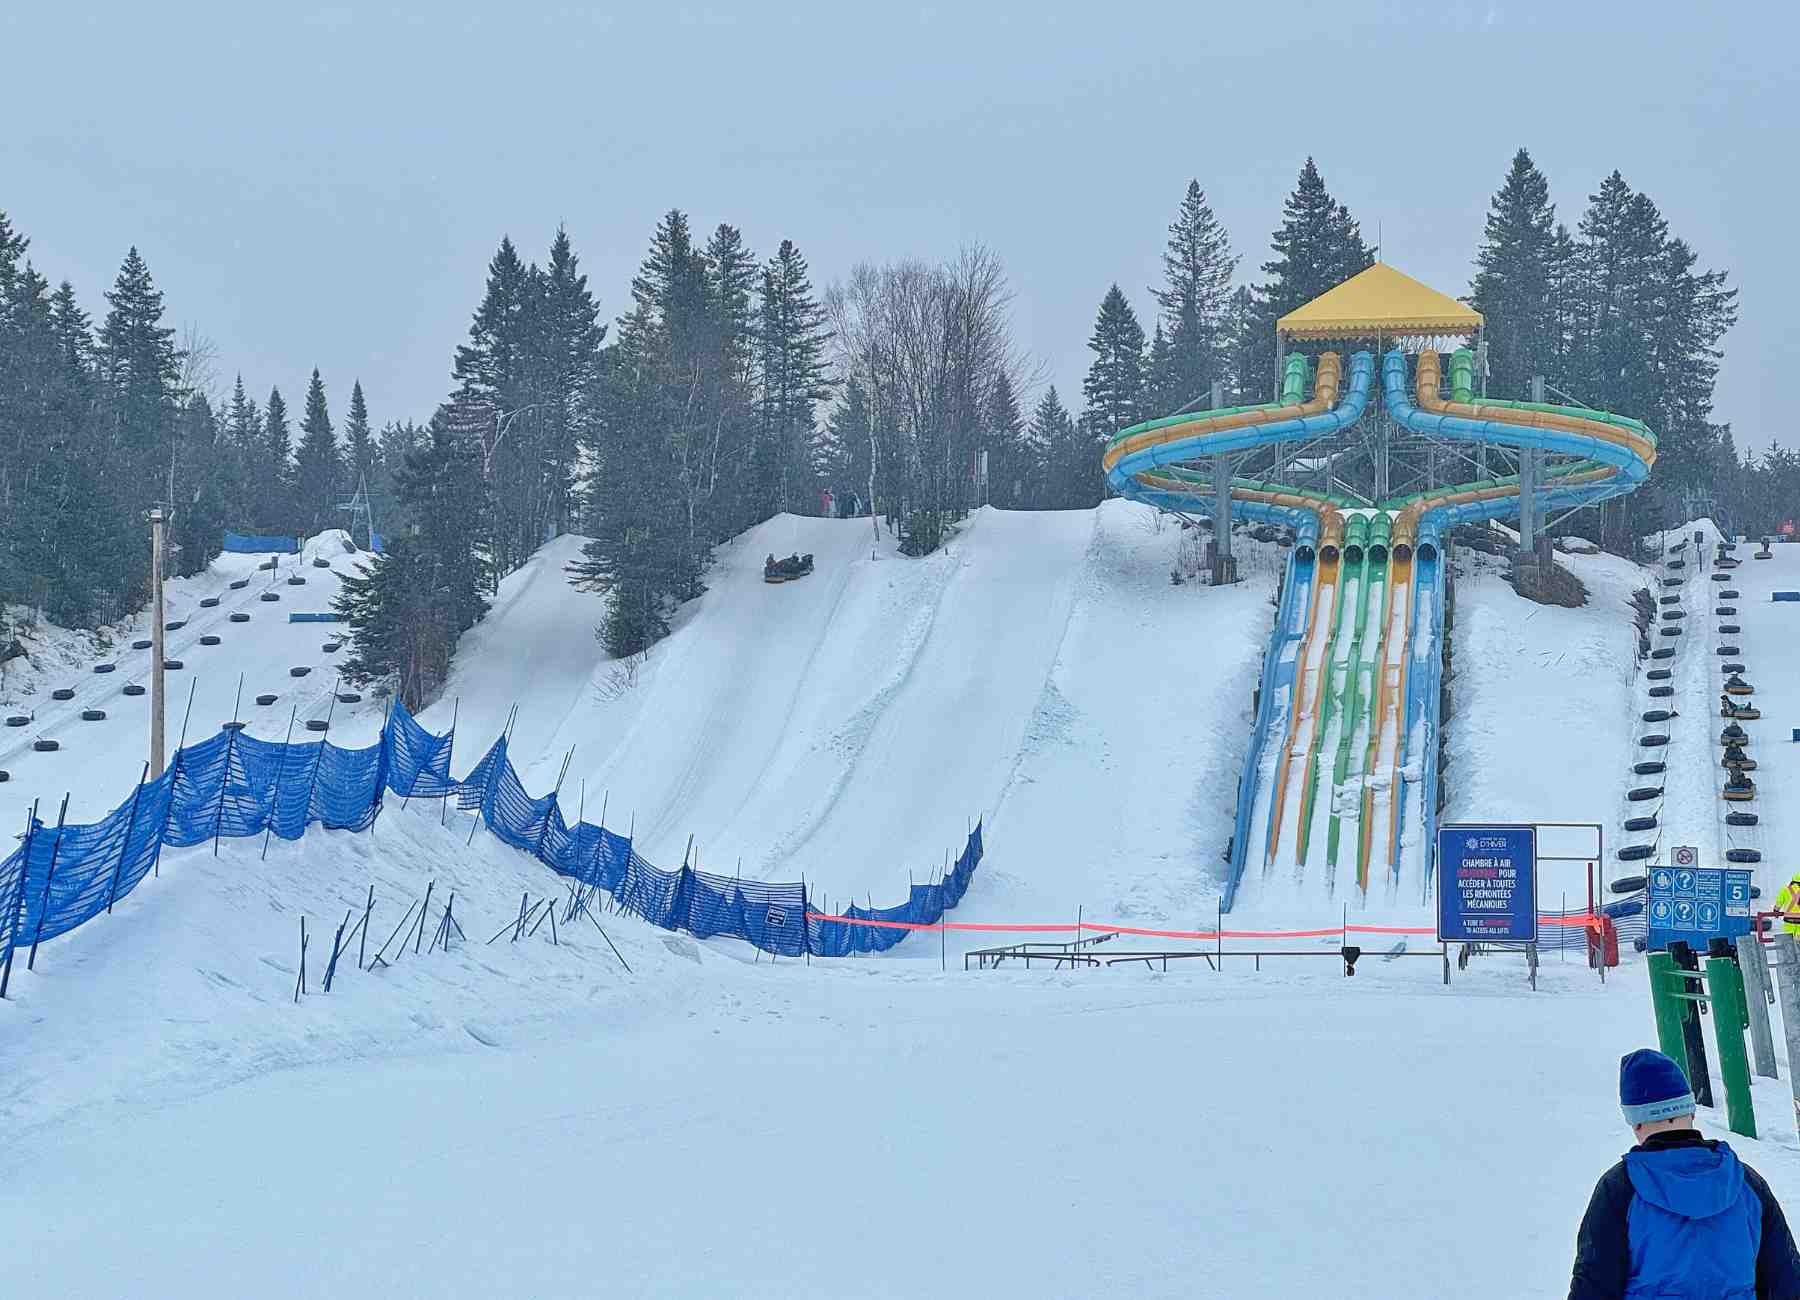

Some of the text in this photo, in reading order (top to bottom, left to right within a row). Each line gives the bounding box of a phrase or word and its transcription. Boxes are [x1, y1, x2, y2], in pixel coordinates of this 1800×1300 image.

[1462, 857, 1511, 868] CHAMBRE À AIR
[1498, 869, 1516, 878] POUR
[1458, 878, 1485, 888] ACCÉDER
[1493, 879, 1516, 888] TOUTES
[1463, 888, 1512, 899] LES REMONTÉES
[1733, 886, 1742, 899] 5
[1467, 898, 1508, 909] MÉCANIQUES
